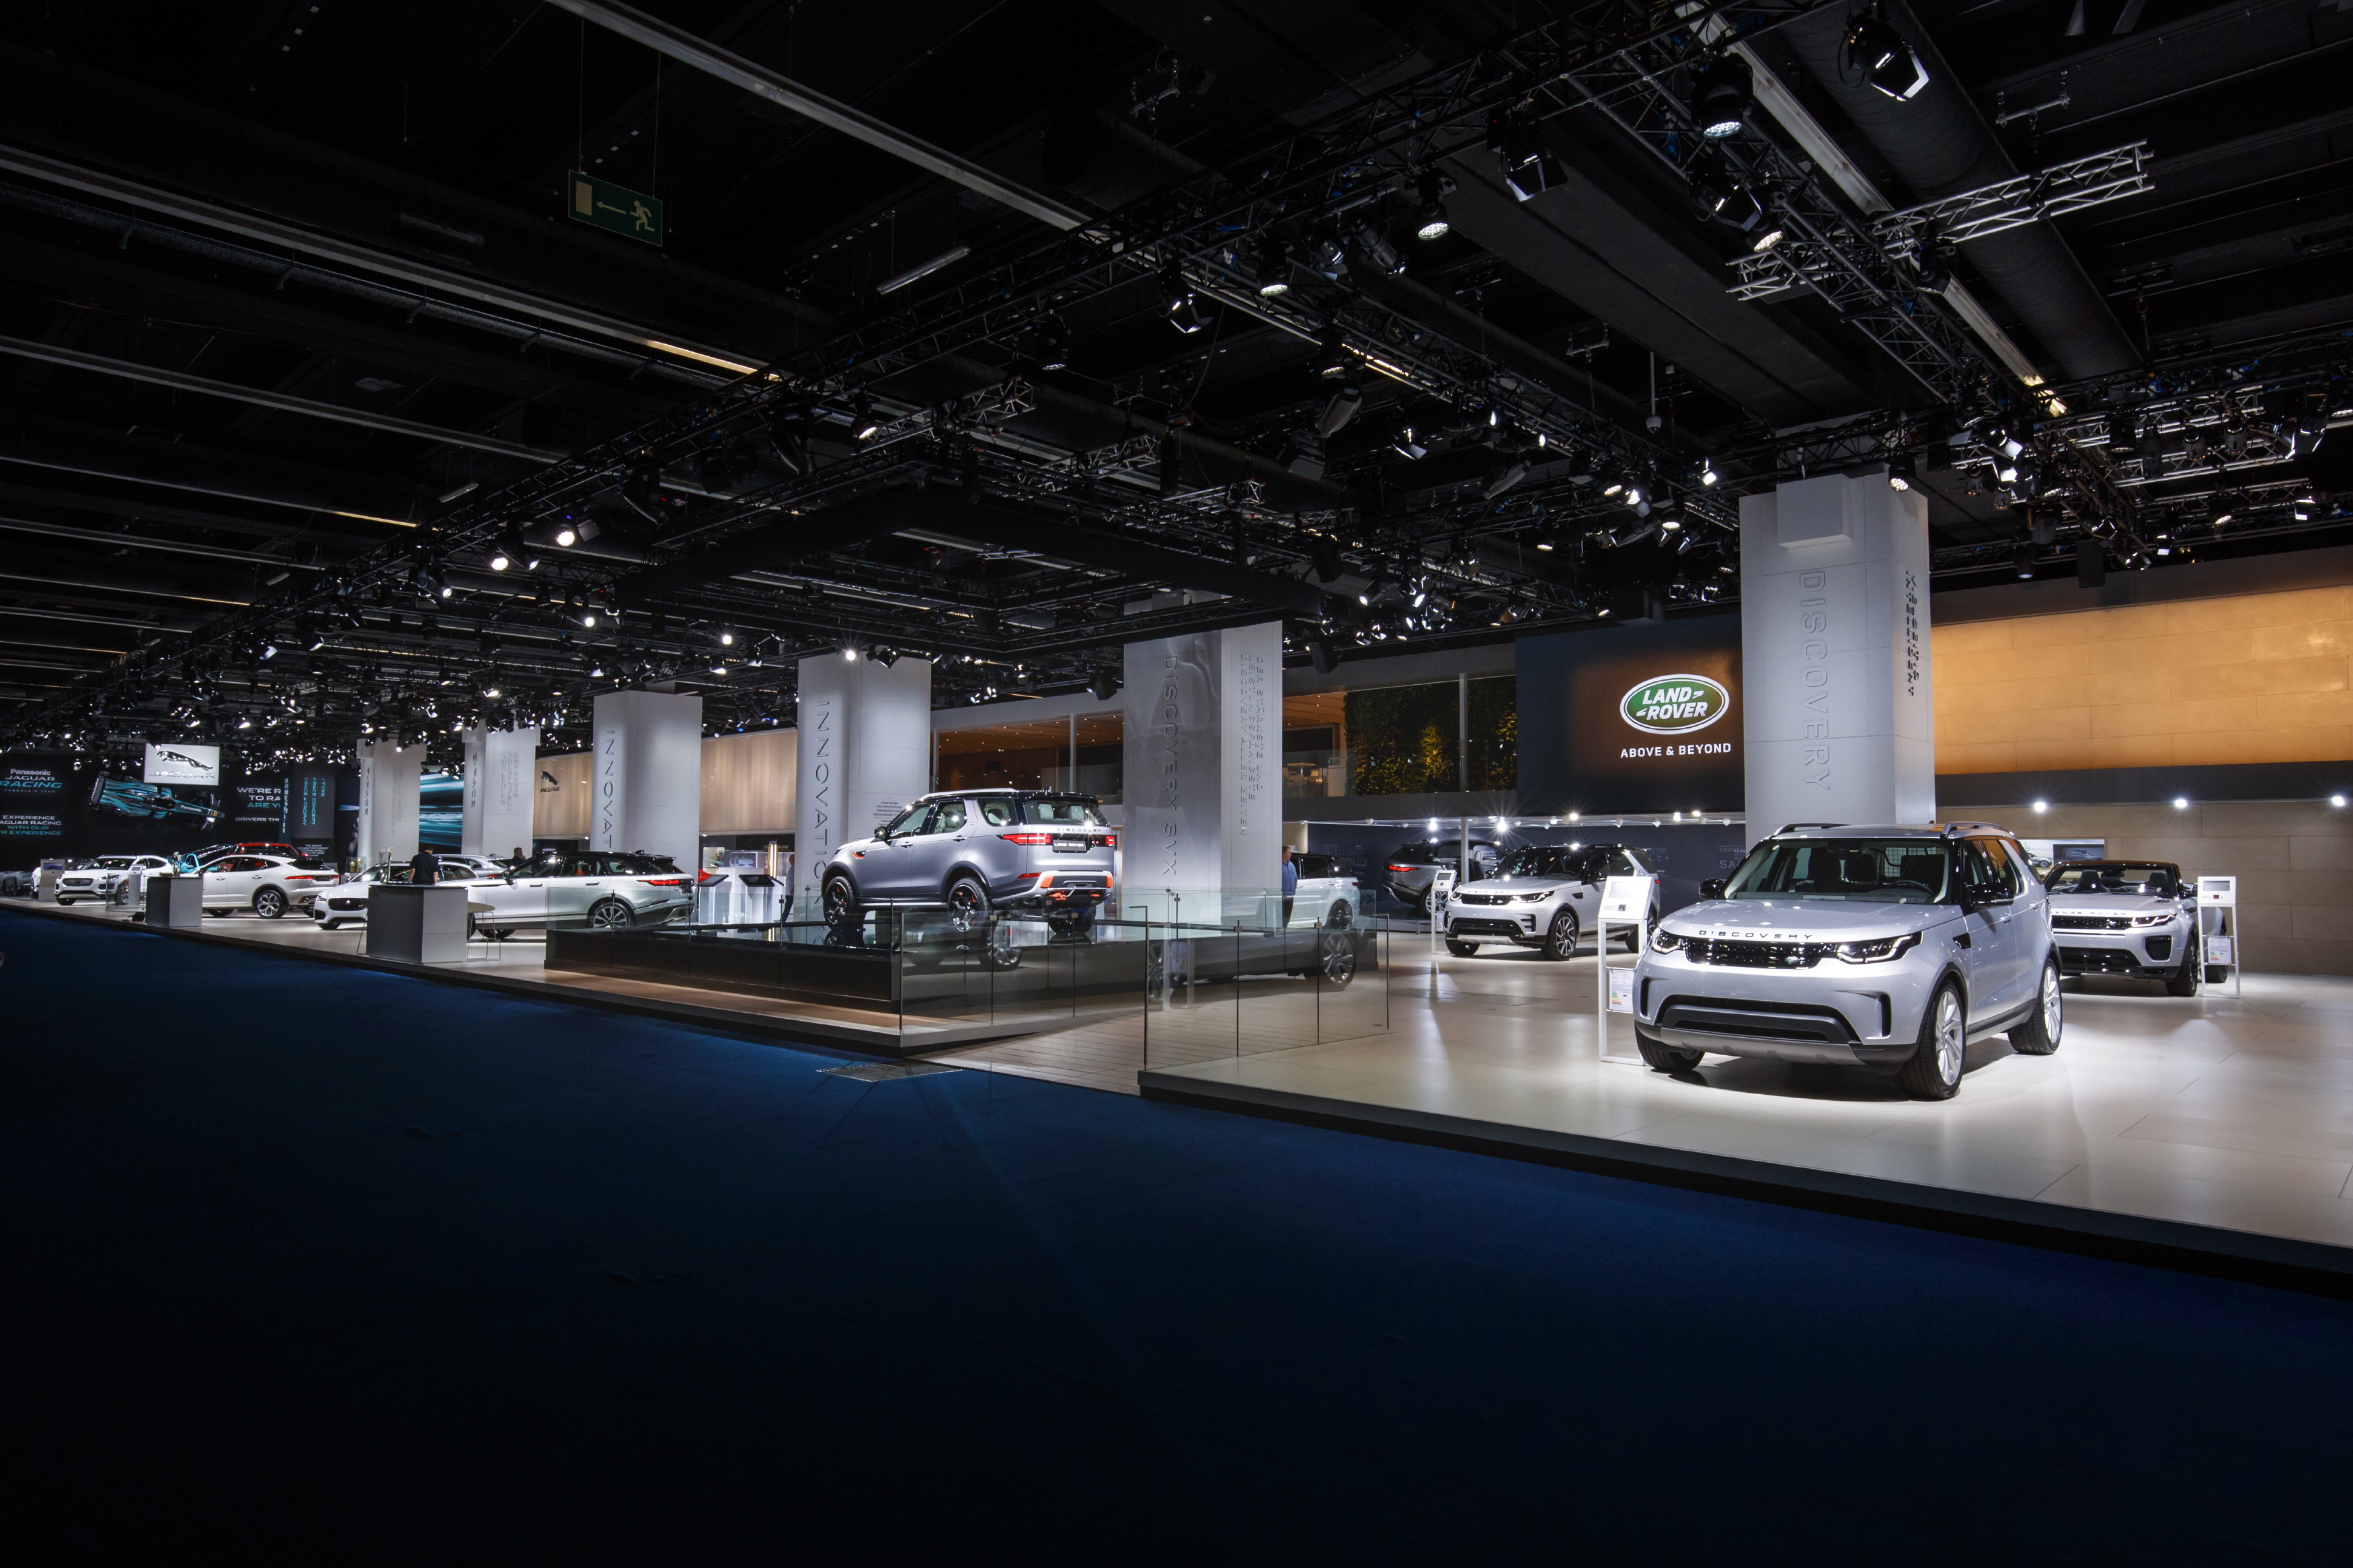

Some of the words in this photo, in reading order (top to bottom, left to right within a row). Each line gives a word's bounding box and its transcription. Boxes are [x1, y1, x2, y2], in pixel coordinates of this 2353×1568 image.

[1906, 571, 1914, 696] INTELLIGENT
[1642, 686, 1692, 705] LAND
[1800, 571, 1830, 791] DISCOVERY
[1248, 655, 1257, 800] LEISTUNGSFÄHIGSTE
[1646, 702, 1708, 720] ROVER
[1163, 656, 1176, 810] DISCOVERY
[1621, 747, 1662, 758] ABOVE
[1666, 745, 1674, 755] &
[1679, 743, 1731, 755] BEYOND
[0, 780, 63, 788] RACING
[602, 731, 614, 848] INNOVAT
[180, 804, 202, 813] Panasonic
[1163, 823, 1176, 875] SVX
[1699, 930, 1813, 940] DISCOVERY
